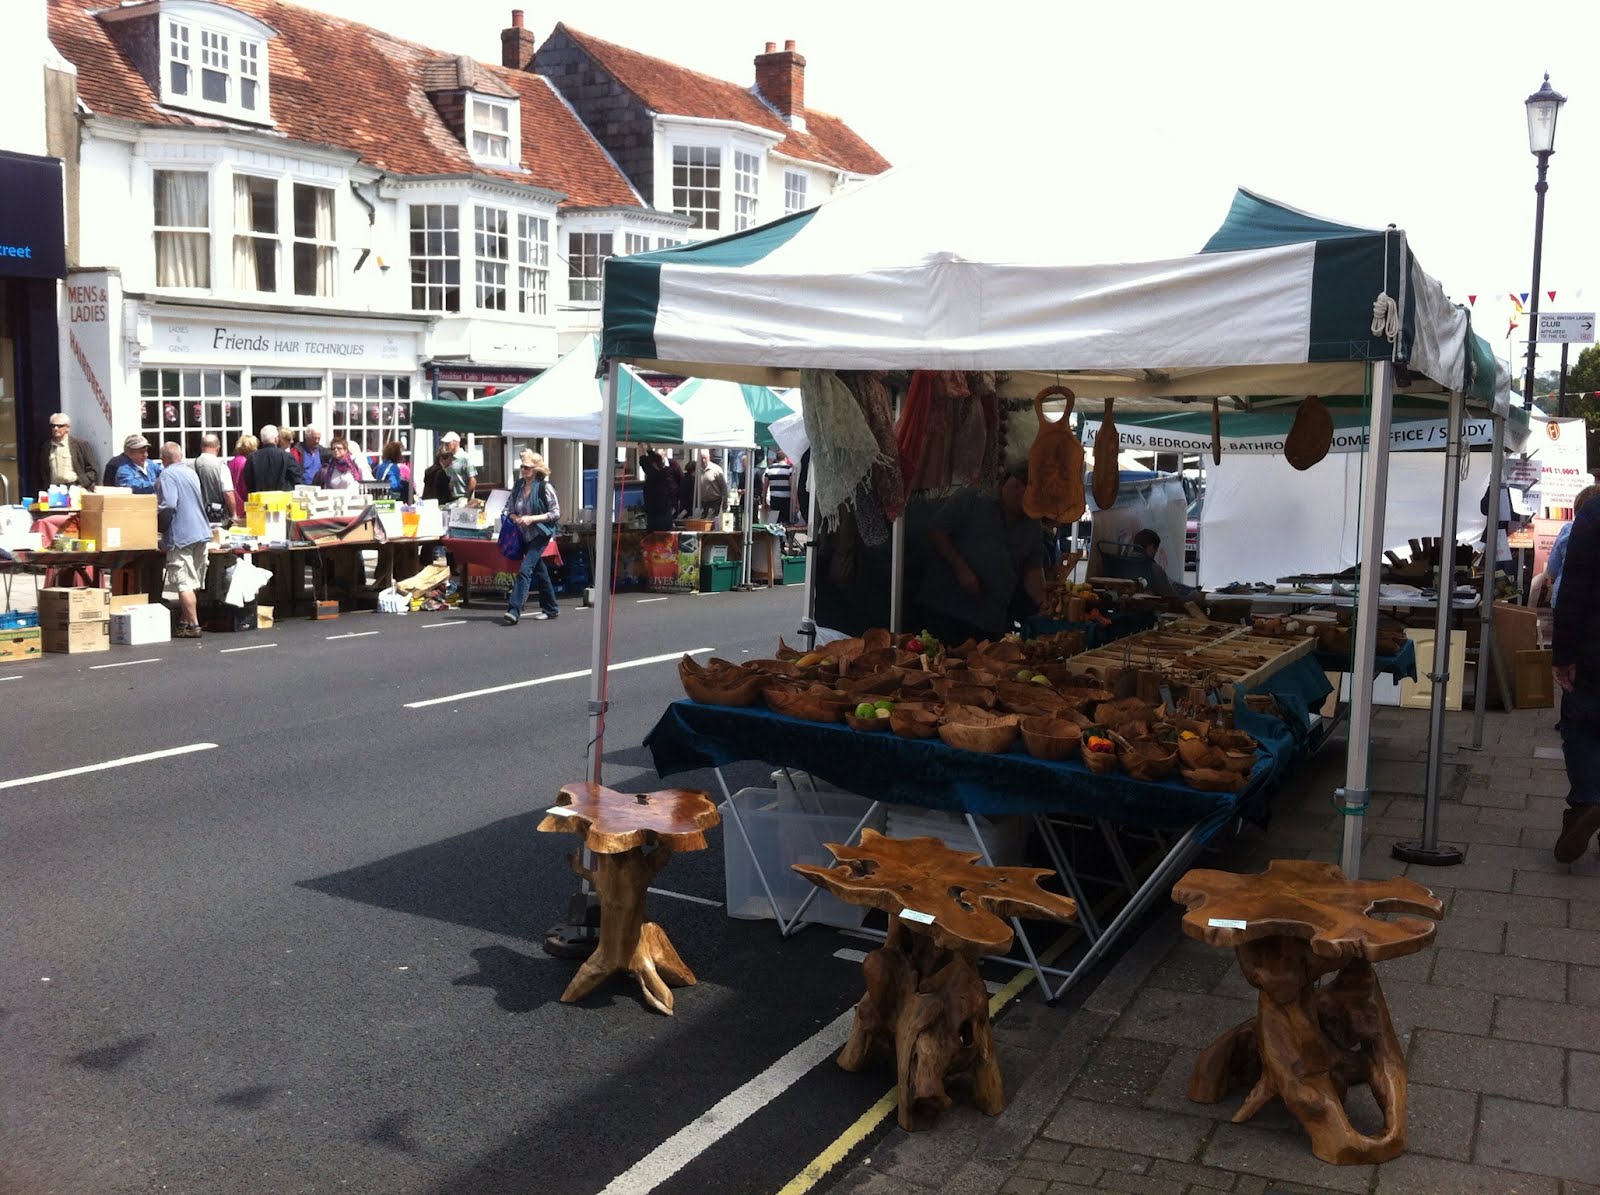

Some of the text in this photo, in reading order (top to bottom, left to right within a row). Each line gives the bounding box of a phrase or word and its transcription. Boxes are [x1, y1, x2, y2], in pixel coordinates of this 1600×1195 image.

[68, 286, 108, 303] MENS &
[70, 305, 106, 322] LADIES
[168, 326, 189, 334] LADIES
[168, 345, 190, 353] GENTS
[213, 327, 364, 356] Friends HAIR TECHNIQUES
[1088, 429, 1145, 446] KENS,
[1149, 436, 1226, 451] BEDROOM,
[1230, 442, 1284, 450] BATHRO
[1390, 430, 1424, 442] FICE
[1439, 424, 1487, 438] SUDY
